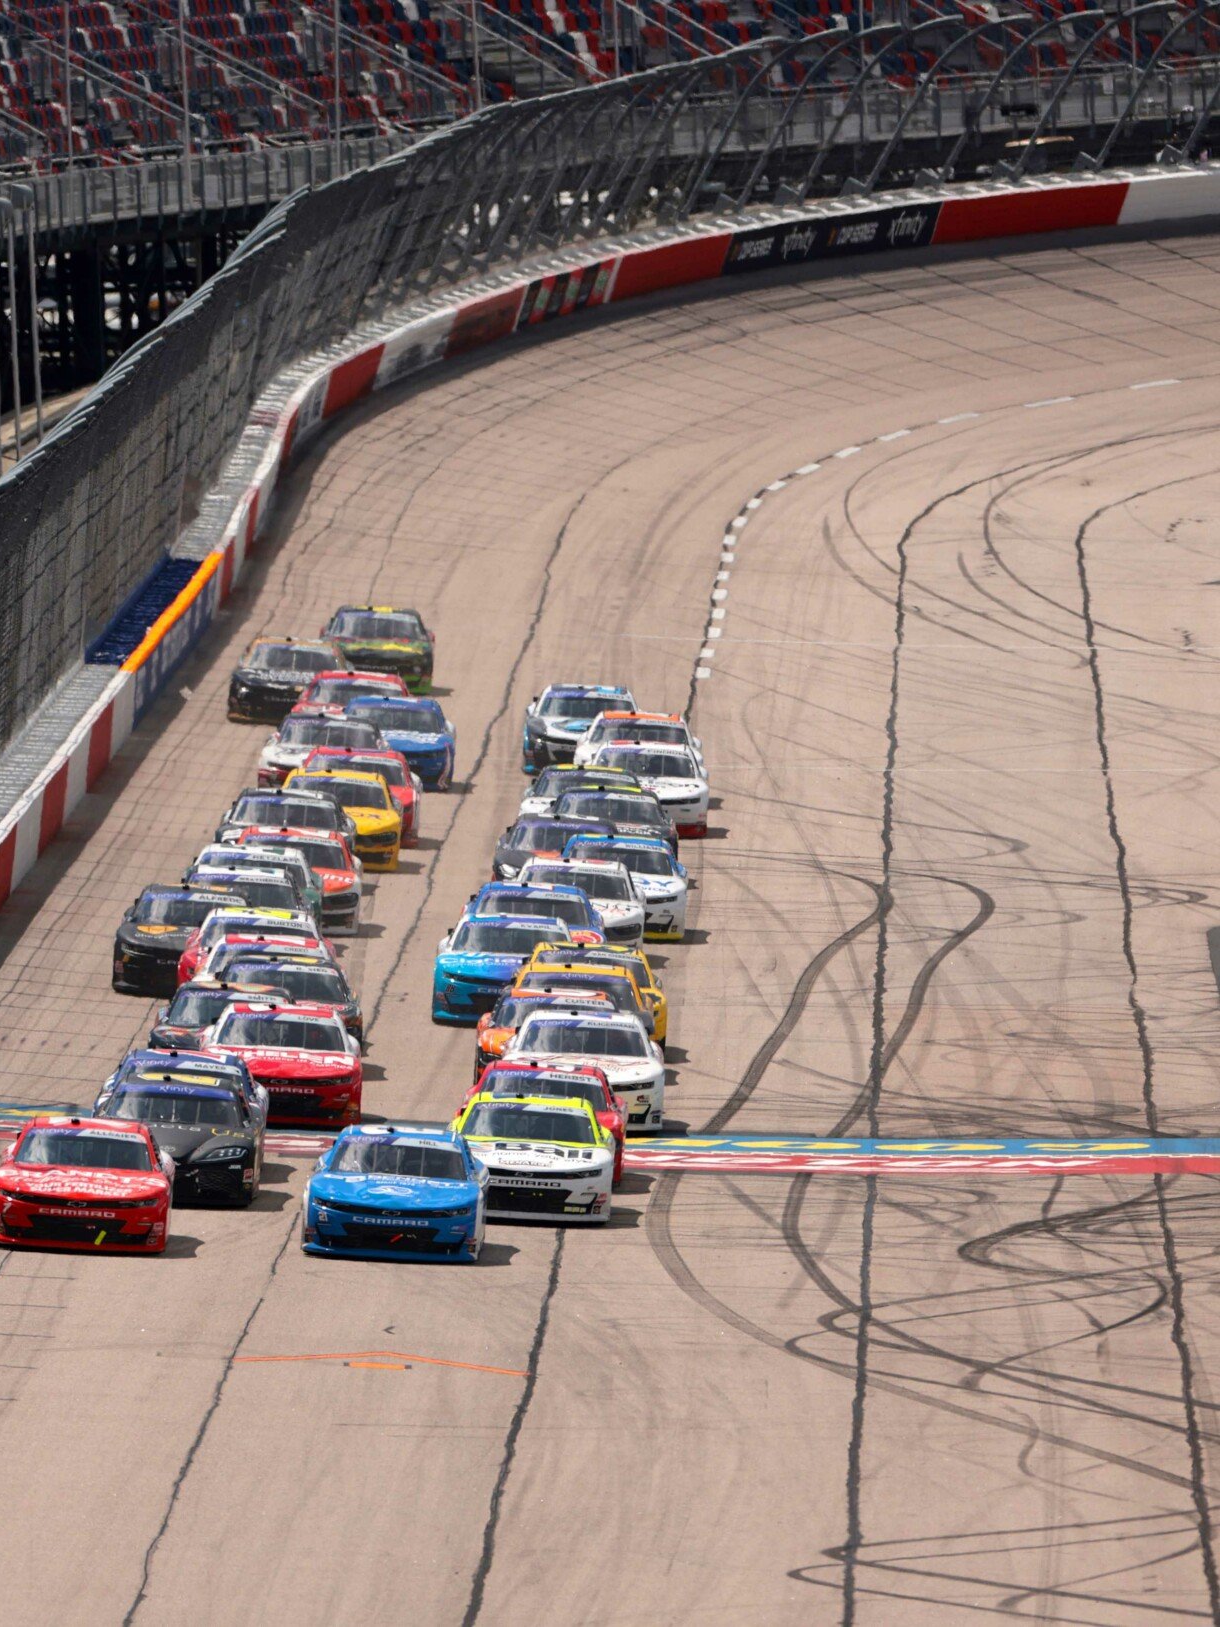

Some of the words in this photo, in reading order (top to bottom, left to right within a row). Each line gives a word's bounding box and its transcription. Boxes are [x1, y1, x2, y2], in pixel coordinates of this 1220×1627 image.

[199, 895, 241, 904] ALFREDO
[267, 920, 303, 928] BURTON
[565, 998, 605, 1006] CUSTER
[537, 1020, 572, 1028] xfinity
[587, 1021, 635, 1029] KLIGERMAN
[134, 1059, 172, 1067] xfinity
[496, 1070, 531, 1078] xfinity
[550, 1073, 592, 1082] HERBST
[159, 1086, 196, 1095] xfinity
[481, 1102, 518, 1110] xfinity
[544, 1105, 574, 1113] JONES
[36, 1128, 73, 1136] xfinity
[90, 1130, 137, 1140] ALLGAIER
[490, 1177, 562, 1188] CAMARO
[38, 1207, 116, 1218] CAMARO
[352, 1215, 429, 1226] CAMARO
